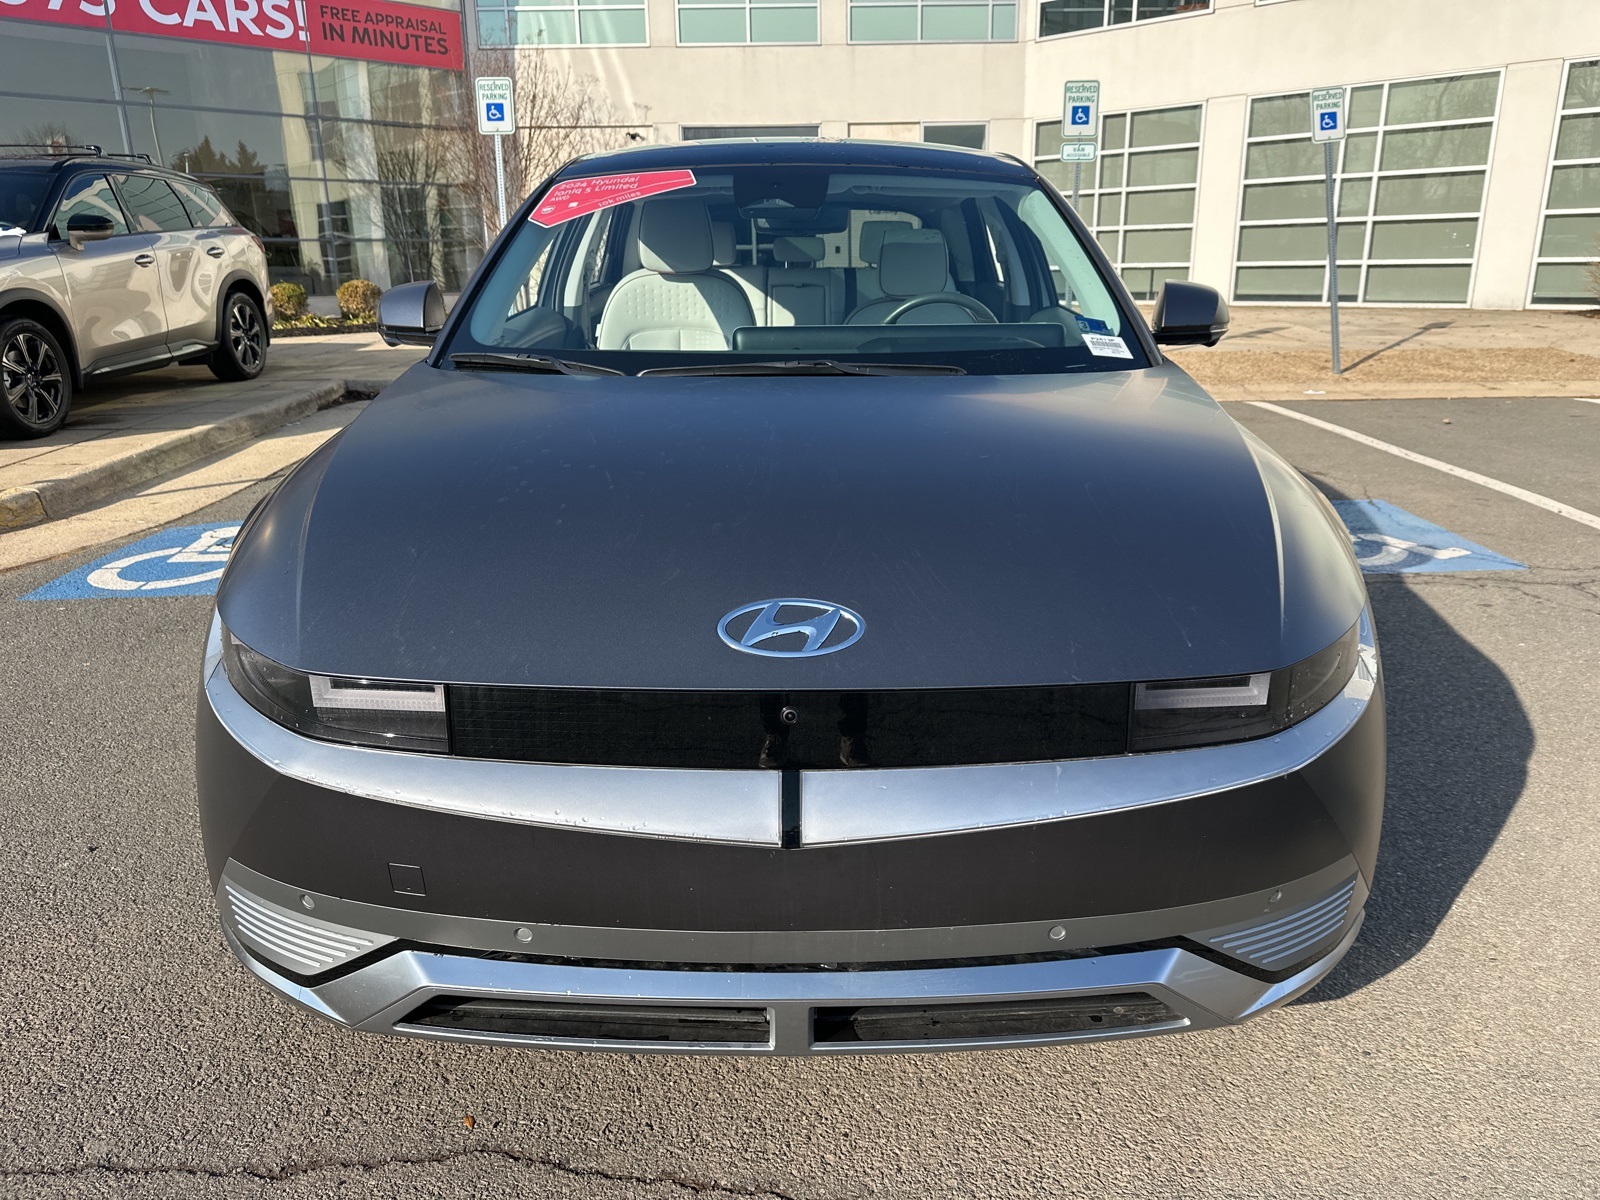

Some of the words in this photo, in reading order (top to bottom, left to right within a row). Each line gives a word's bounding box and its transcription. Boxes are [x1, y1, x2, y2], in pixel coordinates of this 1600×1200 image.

[139, 0, 310, 42] CARS!
[320, 5, 361, 23] FREE
[364, 12, 447, 35] APPRAISAL
[321, 22, 345, 43] IN
[352, 26, 449, 55] MINUTES
[480, 83, 509, 91] RESERVED
[1066, 86, 1098, 94] RESERVED
[1068, 95, 1095, 103] PARKING
[1313, 92, 1343, 101] RESERVED
[1315, 102, 1341, 110] PARKING
[559, 182, 587, 190] 2024
[591, 175, 640, 186] Hyundai
[594, 182, 639, 192] Limited
[616, 191, 641, 202] miles
